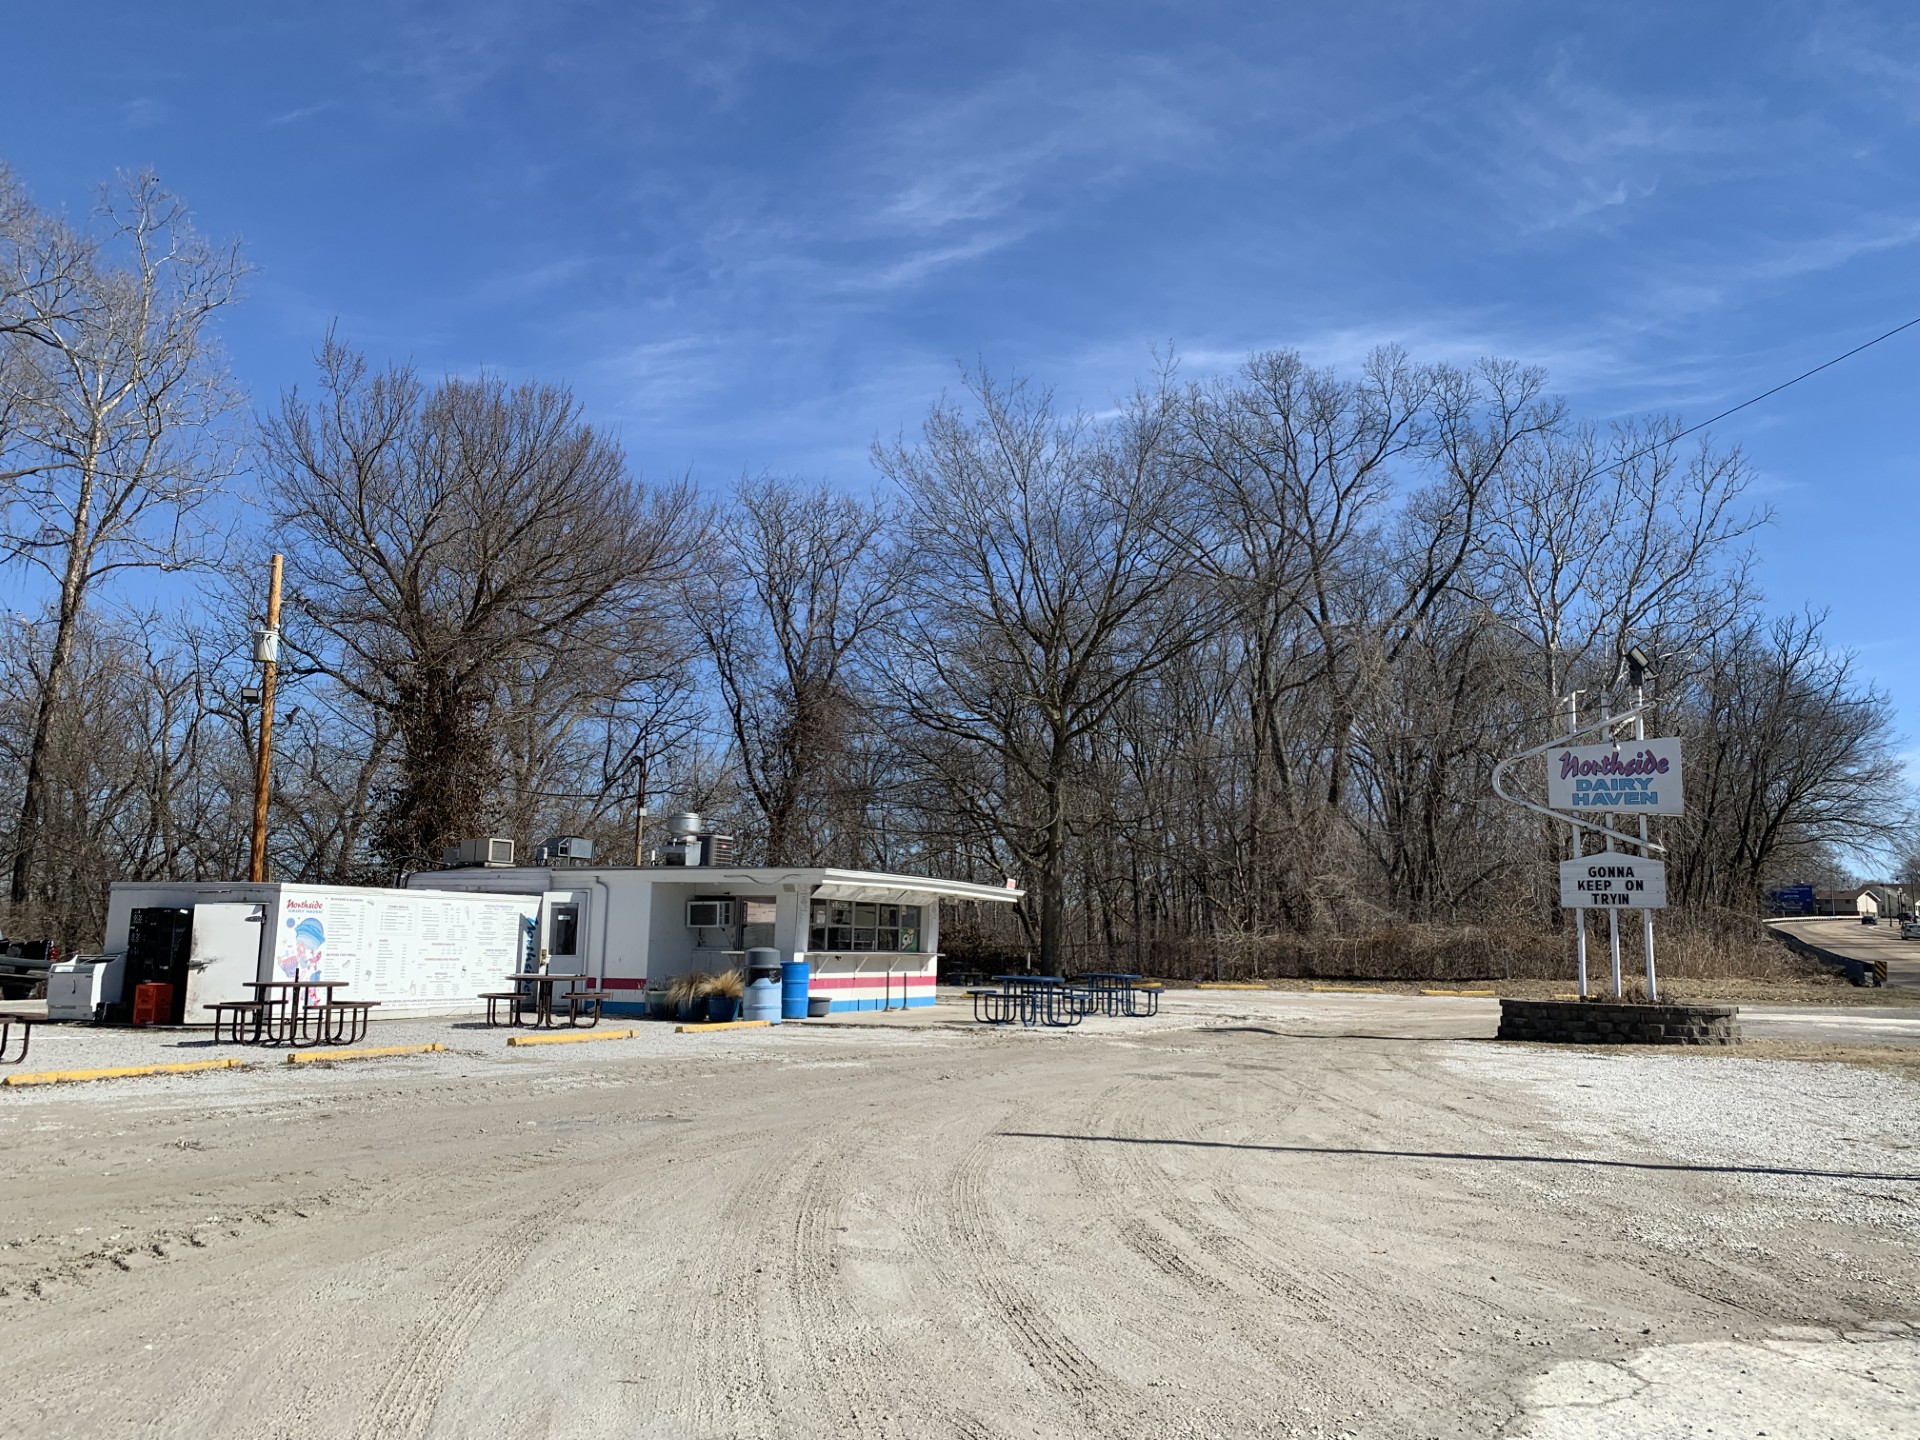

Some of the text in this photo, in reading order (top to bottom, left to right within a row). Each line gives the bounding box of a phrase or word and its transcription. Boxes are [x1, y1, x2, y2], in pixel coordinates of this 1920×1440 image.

[1559, 749, 1670, 780] Northside
[1576, 778, 1654, 791] DAIRY
[1572, 792, 1659, 806] HAVEN
[1588, 866, 1635, 878] GONNA
[1577, 880, 1644, 891] KEEP ON
[285, 898, 323, 909] Northside
[1591, 893, 1630, 905] TRYIN
[523, 916, 539, 993] Northsie
